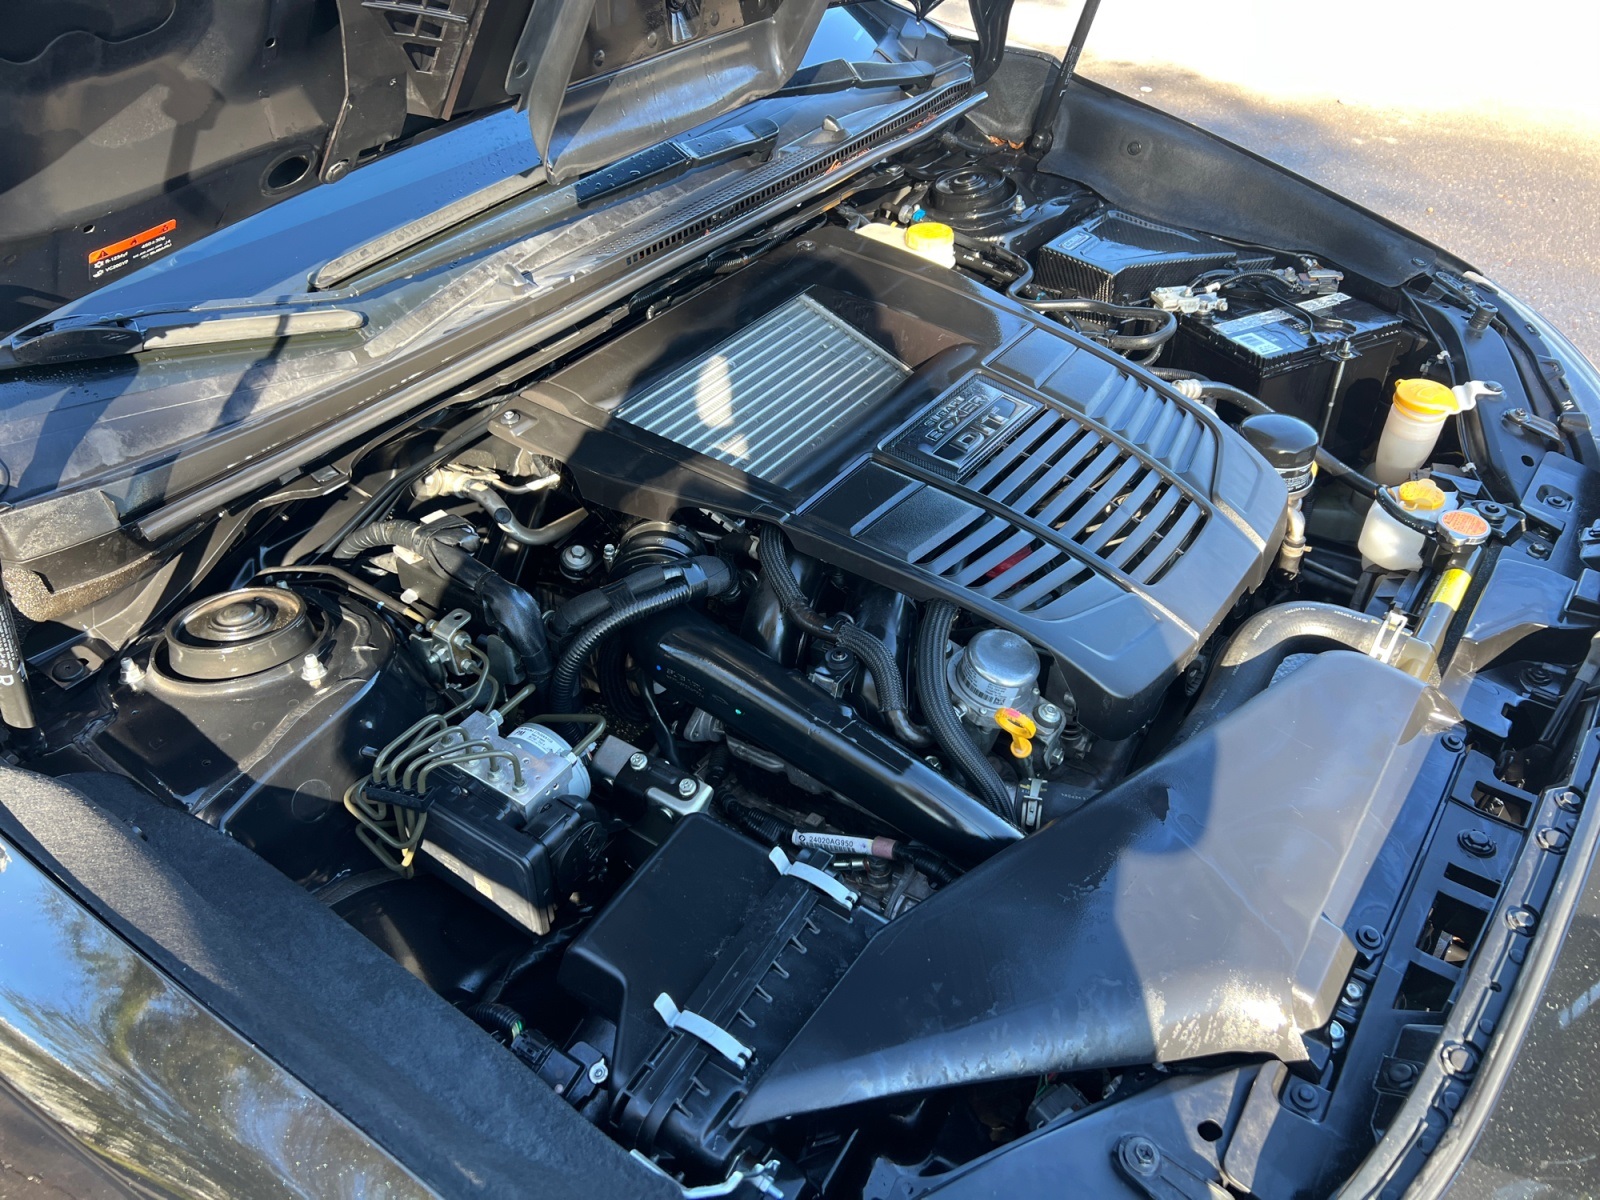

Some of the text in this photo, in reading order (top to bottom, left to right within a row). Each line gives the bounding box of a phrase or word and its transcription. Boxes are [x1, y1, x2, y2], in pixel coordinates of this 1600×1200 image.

[925, 394, 990, 442] BOXER
[949, 406, 1010, 453] DIT
[809, 836, 853, 847] 24020AG950
